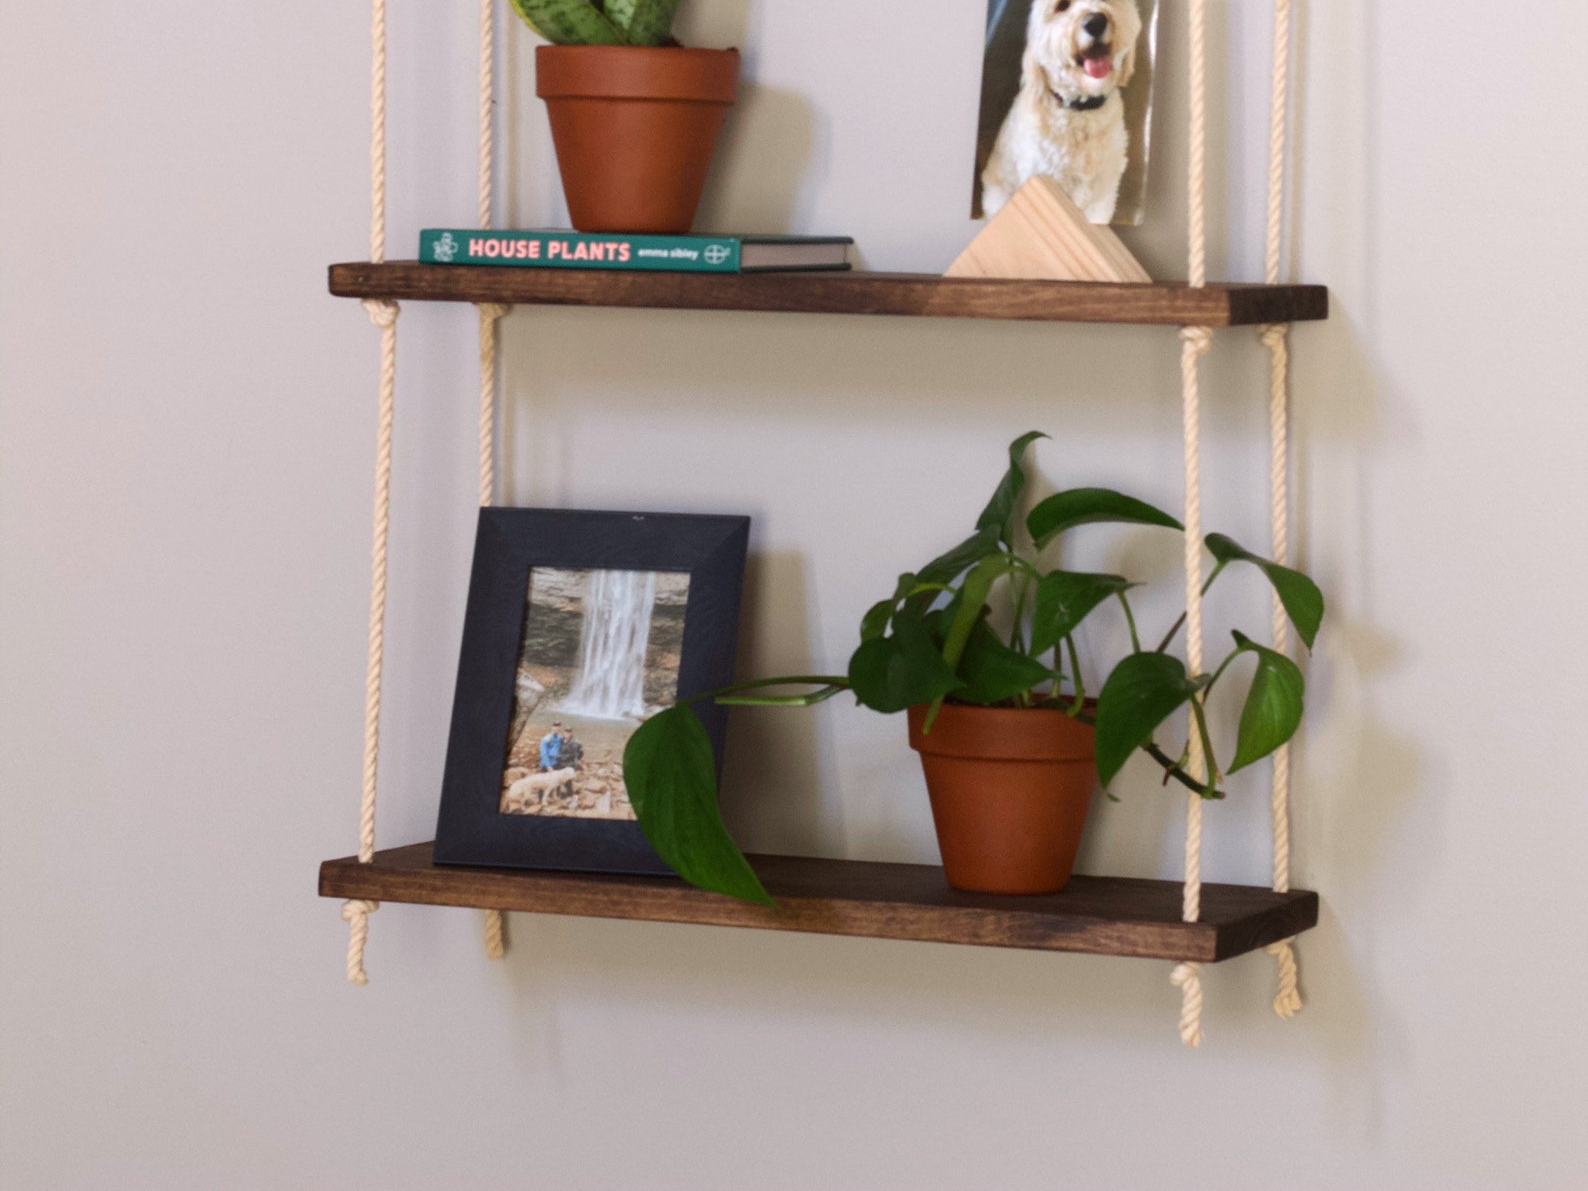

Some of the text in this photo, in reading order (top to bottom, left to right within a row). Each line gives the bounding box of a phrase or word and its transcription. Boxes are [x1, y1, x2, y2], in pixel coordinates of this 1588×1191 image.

[469, 238, 540, 258] HOUSE
[548, 241, 631, 262] PLANTS
[638, 248, 668, 258] emma
